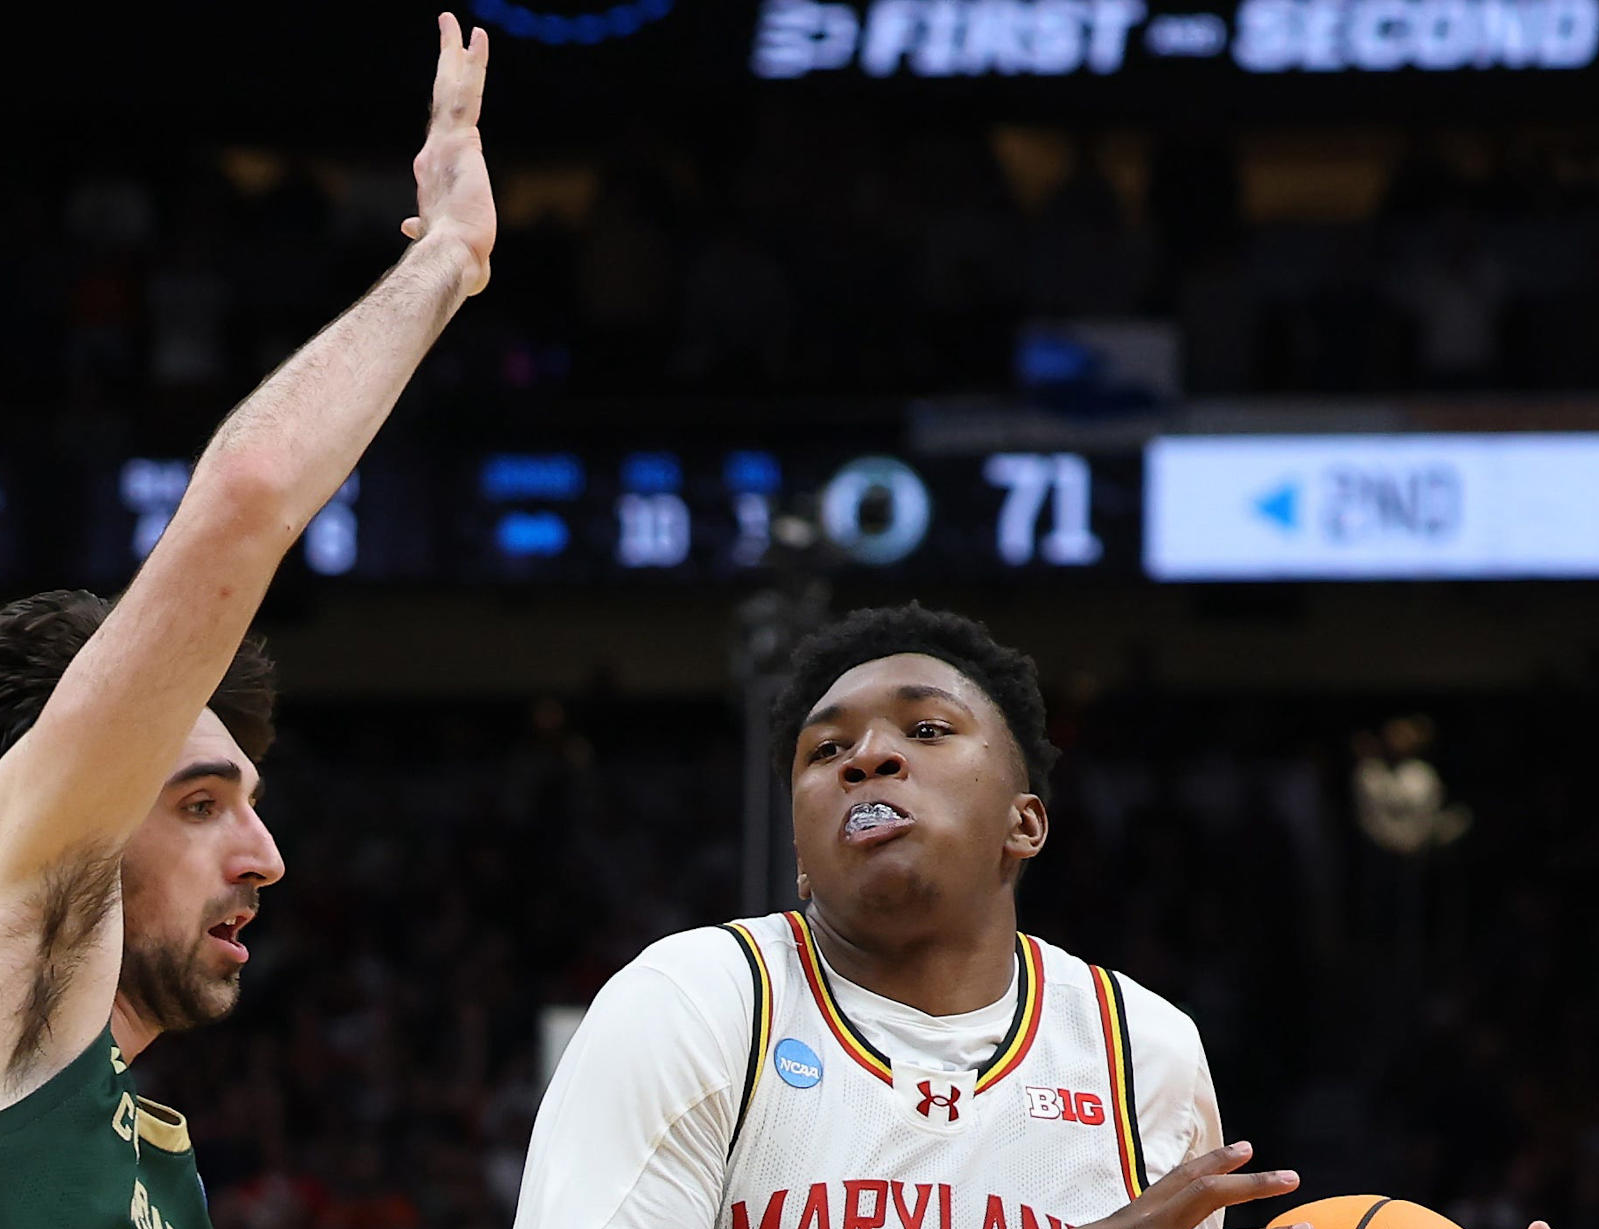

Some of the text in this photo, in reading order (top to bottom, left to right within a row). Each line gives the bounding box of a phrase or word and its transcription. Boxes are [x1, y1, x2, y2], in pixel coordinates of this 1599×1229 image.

[859, 0, 1146, 77] FIRST
[985, 451, 1102, 566] 71
[779, 1057, 820, 1079] NCAA
